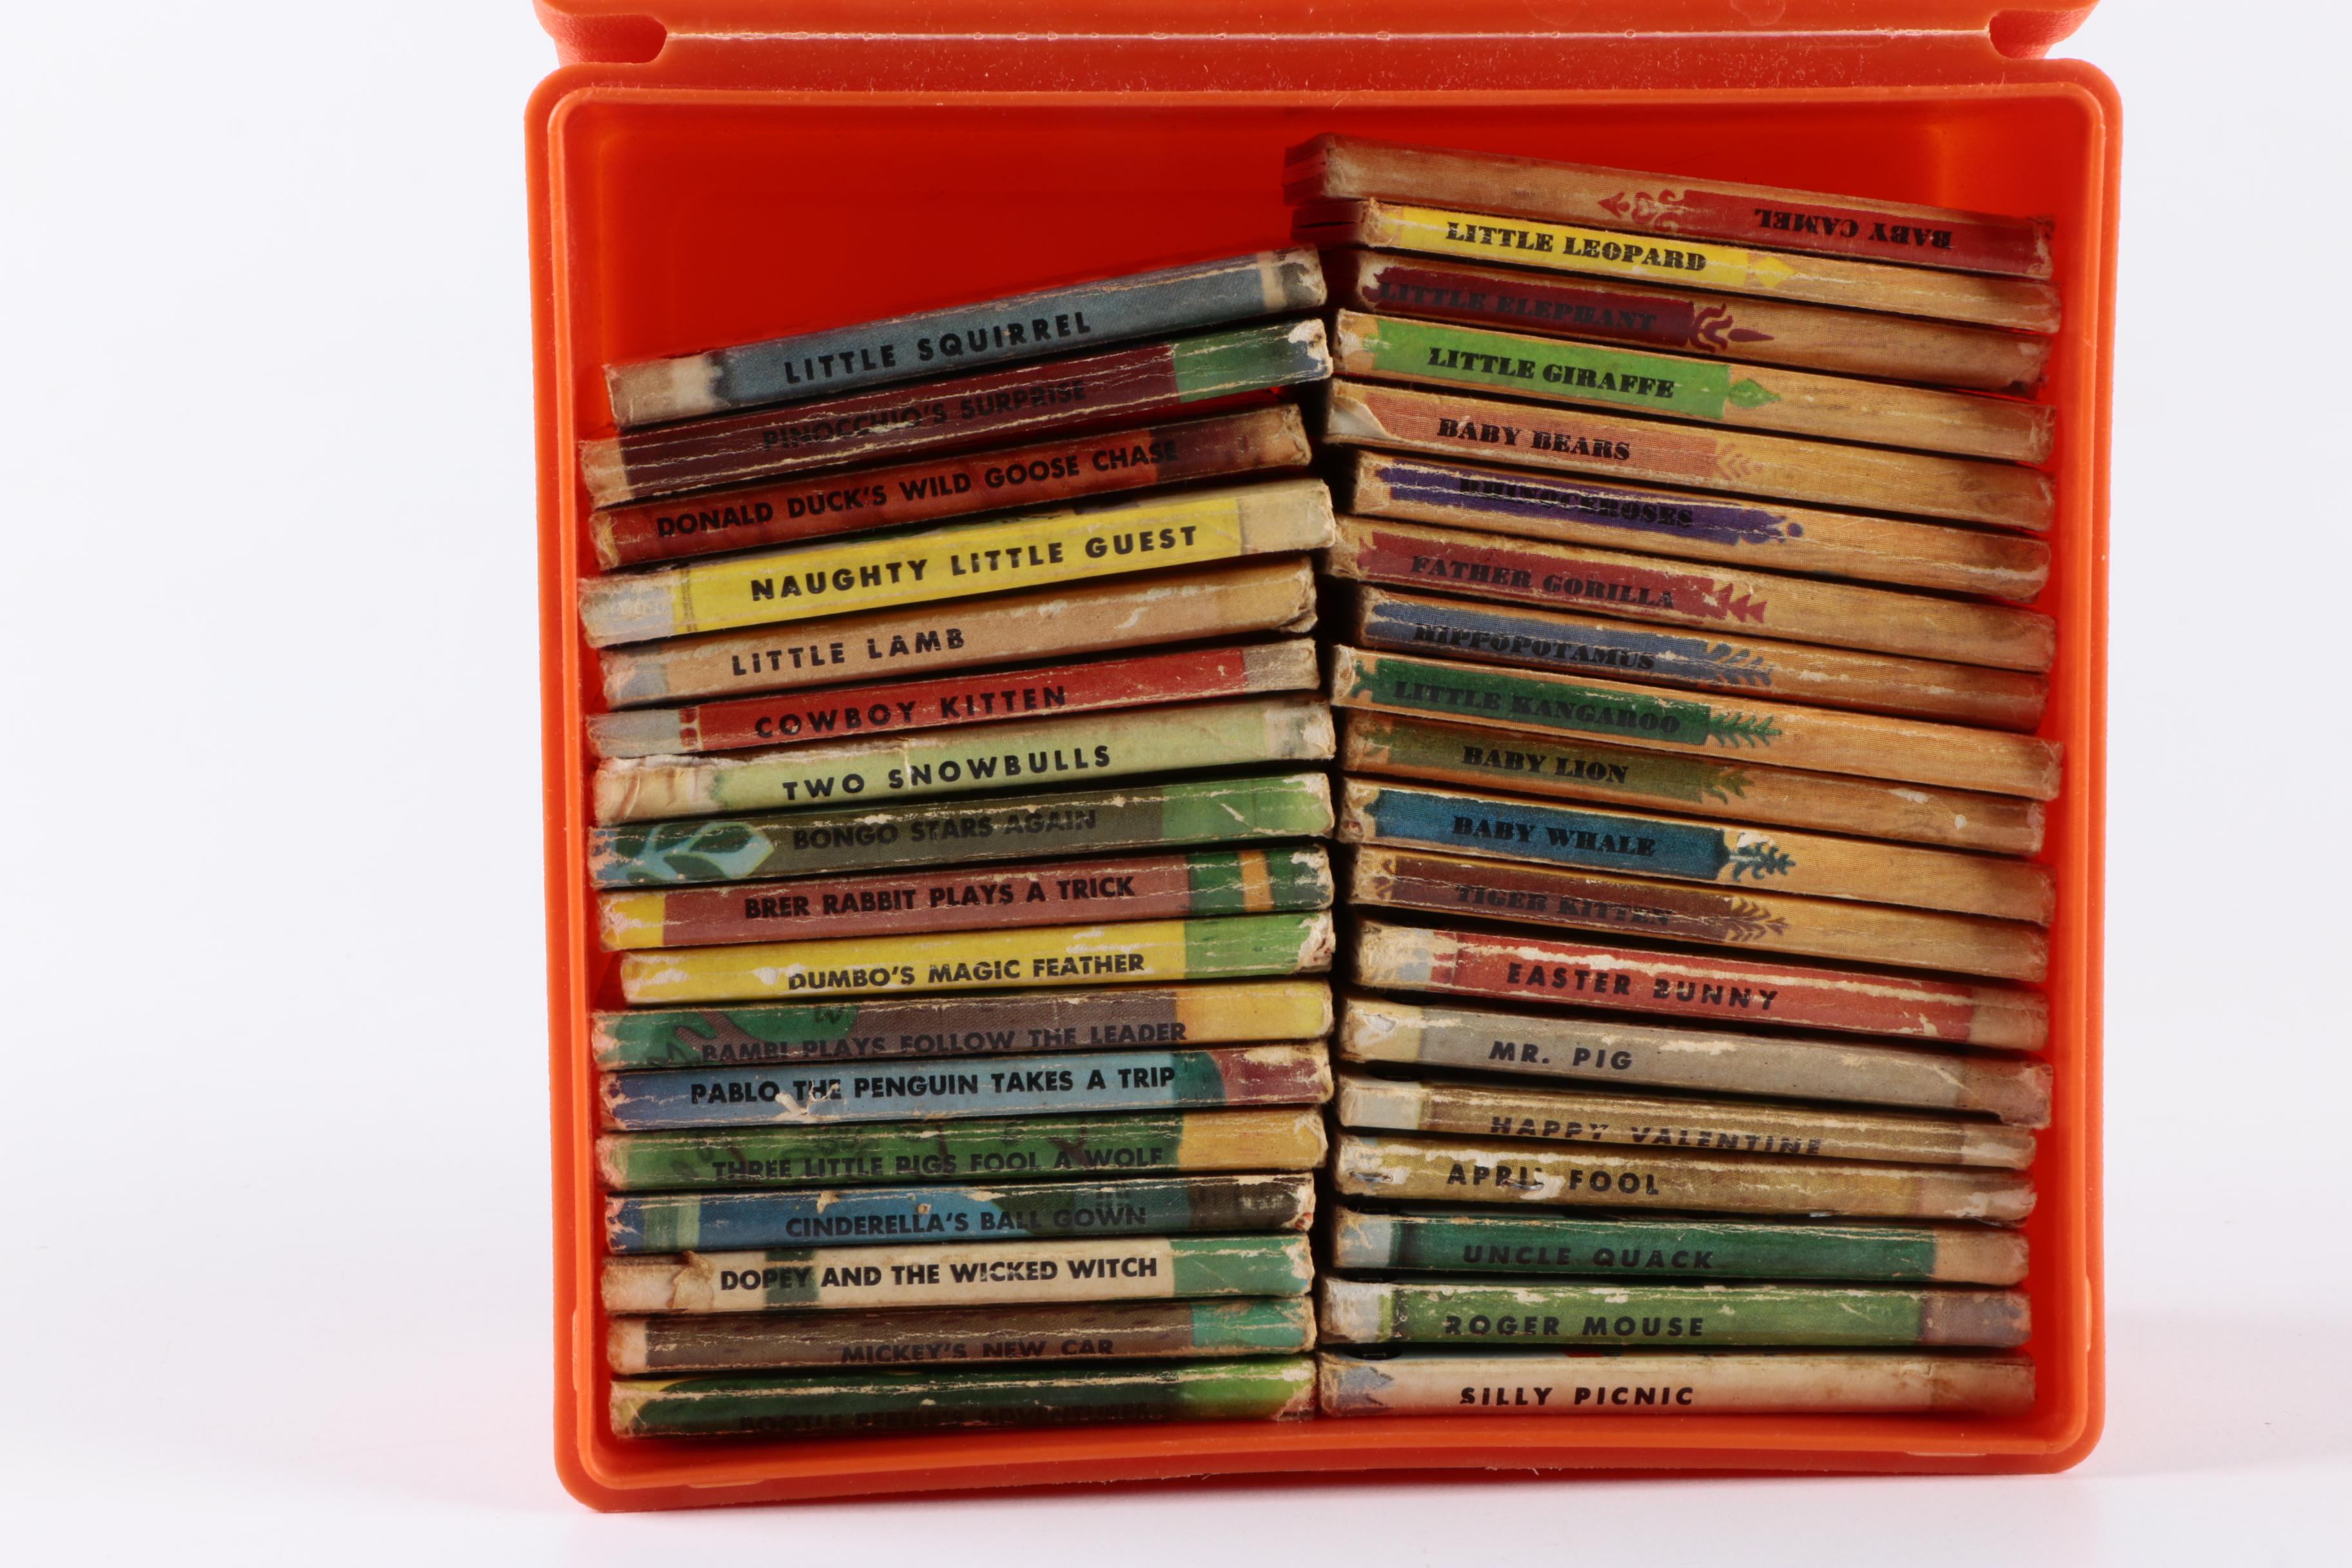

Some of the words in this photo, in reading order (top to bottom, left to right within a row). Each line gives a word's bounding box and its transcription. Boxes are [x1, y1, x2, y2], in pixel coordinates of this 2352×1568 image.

[1754, 208, 1859, 239] CAMEL
[1868, 222, 1954, 250] BABY
[1446, 221, 1554, 253] LITTLE
[1563, 237, 1708, 272] LEOPARD
[1377, 281, 1486, 311] LITTLE
[1496, 297, 1658, 332] ELEPHANT
[785, 344, 896, 384] LITTLE
[917, 311, 1091, 361] SQUIRREL
[1427, 346, 1536, 380] LITTLE
[1542, 364, 1676, 399] GIRAFFE
[763, 402, 948, 450] PINOCCHIO'S
[961, 380, 1087, 420] SURPRISE
[1436, 417, 1522, 446] BABY
[1530, 430, 1631, 461] BEARS
[656, 502, 773, 538] DONALD
[787, 485, 887, 518] DUCK'S
[899, 473, 971, 501] WILD
[985, 455, 1080, 488] GOOSE
[1092, 441, 1179, 471] CHASE
[750, 559, 928, 601] NAUGHTY
[951, 542, 1063, 576] LITTLE
[1085, 526, 1197, 558] GUEST
[1410, 555, 1533, 589] FATHER
[1542, 574, 1675, 609] GORILLA
[732, 643, 845, 676] LITTLE
[867, 628, 965, 659] LAMB
[1413, 622, 1655, 671] HIPPOPOTAMUS
[756, 701, 916, 738] COWBOY
[941, 685, 1066, 718] KITTEN
[1393, 680, 1502, 712] LITTLE
[1511, 694, 1681, 734] KANGAROO
[783, 774, 865, 801] TWO
[888, 745, 1110, 789] SNOWBULLS
[1462, 745, 1547, 773] BABY
[1554, 756, 1629, 784] LION
[793, 823, 899, 850] BONGO
[910, 816, 994, 842] STARS
[1004, 809, 1096, 834] AGAIN
[1451, 816, 1536, 843] BABY
[1545, 826, 1656, 857] WHALE
[745, 896, 810, 919] BRER
[822, 889, 917, 914] RABBIT
[930, 883, 1014, 908] PLAYS
[1026, 881, 1046, 901] A
[1057, 876, 1135, 899] TRICK
[1455, 884, 1547, 912] TIGER
[1557, 894, 1674, 927] KITTEN
[788, 965, 915, 990] DUMBO'S
[928, 959, 1019, 983] MAGIC
[1033, 954, 1144, 977] FEATHER
[1507, 962, 1632, 996] EASTER
[1652, 978, 1779, 1012] BUNNY
[701, 1041, 788, 1062] BAMBI
[803, 1037, 886, 1058] PLAYS
[901, 1031, 1015, 1054] FOLLOW
[1031, 1028, 1077, 1047] THE
[1091, 1022, 1187, 1044] LEADER
[1488, 1040, 1551, 1064] MR.
[1573, 1047, 1633, 1070] PIG
[691, 1081, 779, 1104] PABLO
[793, 1079, 842, 1101] THE
[854, 1074, 978, 1099] PENGUIN
[991, 1071, 1073, 1093] TAKES
[1087, 1069, 1106, 1090] A
[1118, 1067, 1175, 1089] TRIP
[1489, 1115, 1609, 1141] HAPPY
[1631, 1125, 1822, 1156] VALENTINE
[712, 1159, 791, 1181] THREE
[805, 1157, 883, 1179] LITTLE
[896, 1154, 957, 1175] PIGS
[970, 1151, 1044, 1173] FOOL
[1054, 1151, 1073, 1170] A
[1084, 1148, 1163, 1168] WOLF
[1569, 1169, 1660, 1196] FOOL
[785, 1212, 970, 1237] CINDERELLA'S
[980, 1210, 1043, 1231] BALL
[1052, 1206, 1146, 1228] GOWN
[720, 1266, 812, 1291] DOPEY
[821, 1266, 882, 1288] AND
[891, 1264, 941, 1285] THE
[949, 1260, 1059, 1284] WICKED
[1067, 1257, 1157, 1280] WITCH
[1462, 1244, 1572, 1266] UNCLE
[1592, 1247, 1714, 1269] QUACK
[1444, 1314, 1560, 1337] ROGER
[1581, 1315, 1704, 1337] MOUSE
[841, 1342, 967, 1363] MICKEY'S
[982, 1340, 1046, 1358] NEW
[1061, 1338, 1114, 1356] CAR
[1458, 1386, 1553, 1407] SILLY
[1573, 1386, 1694, 1406] PICNIC
